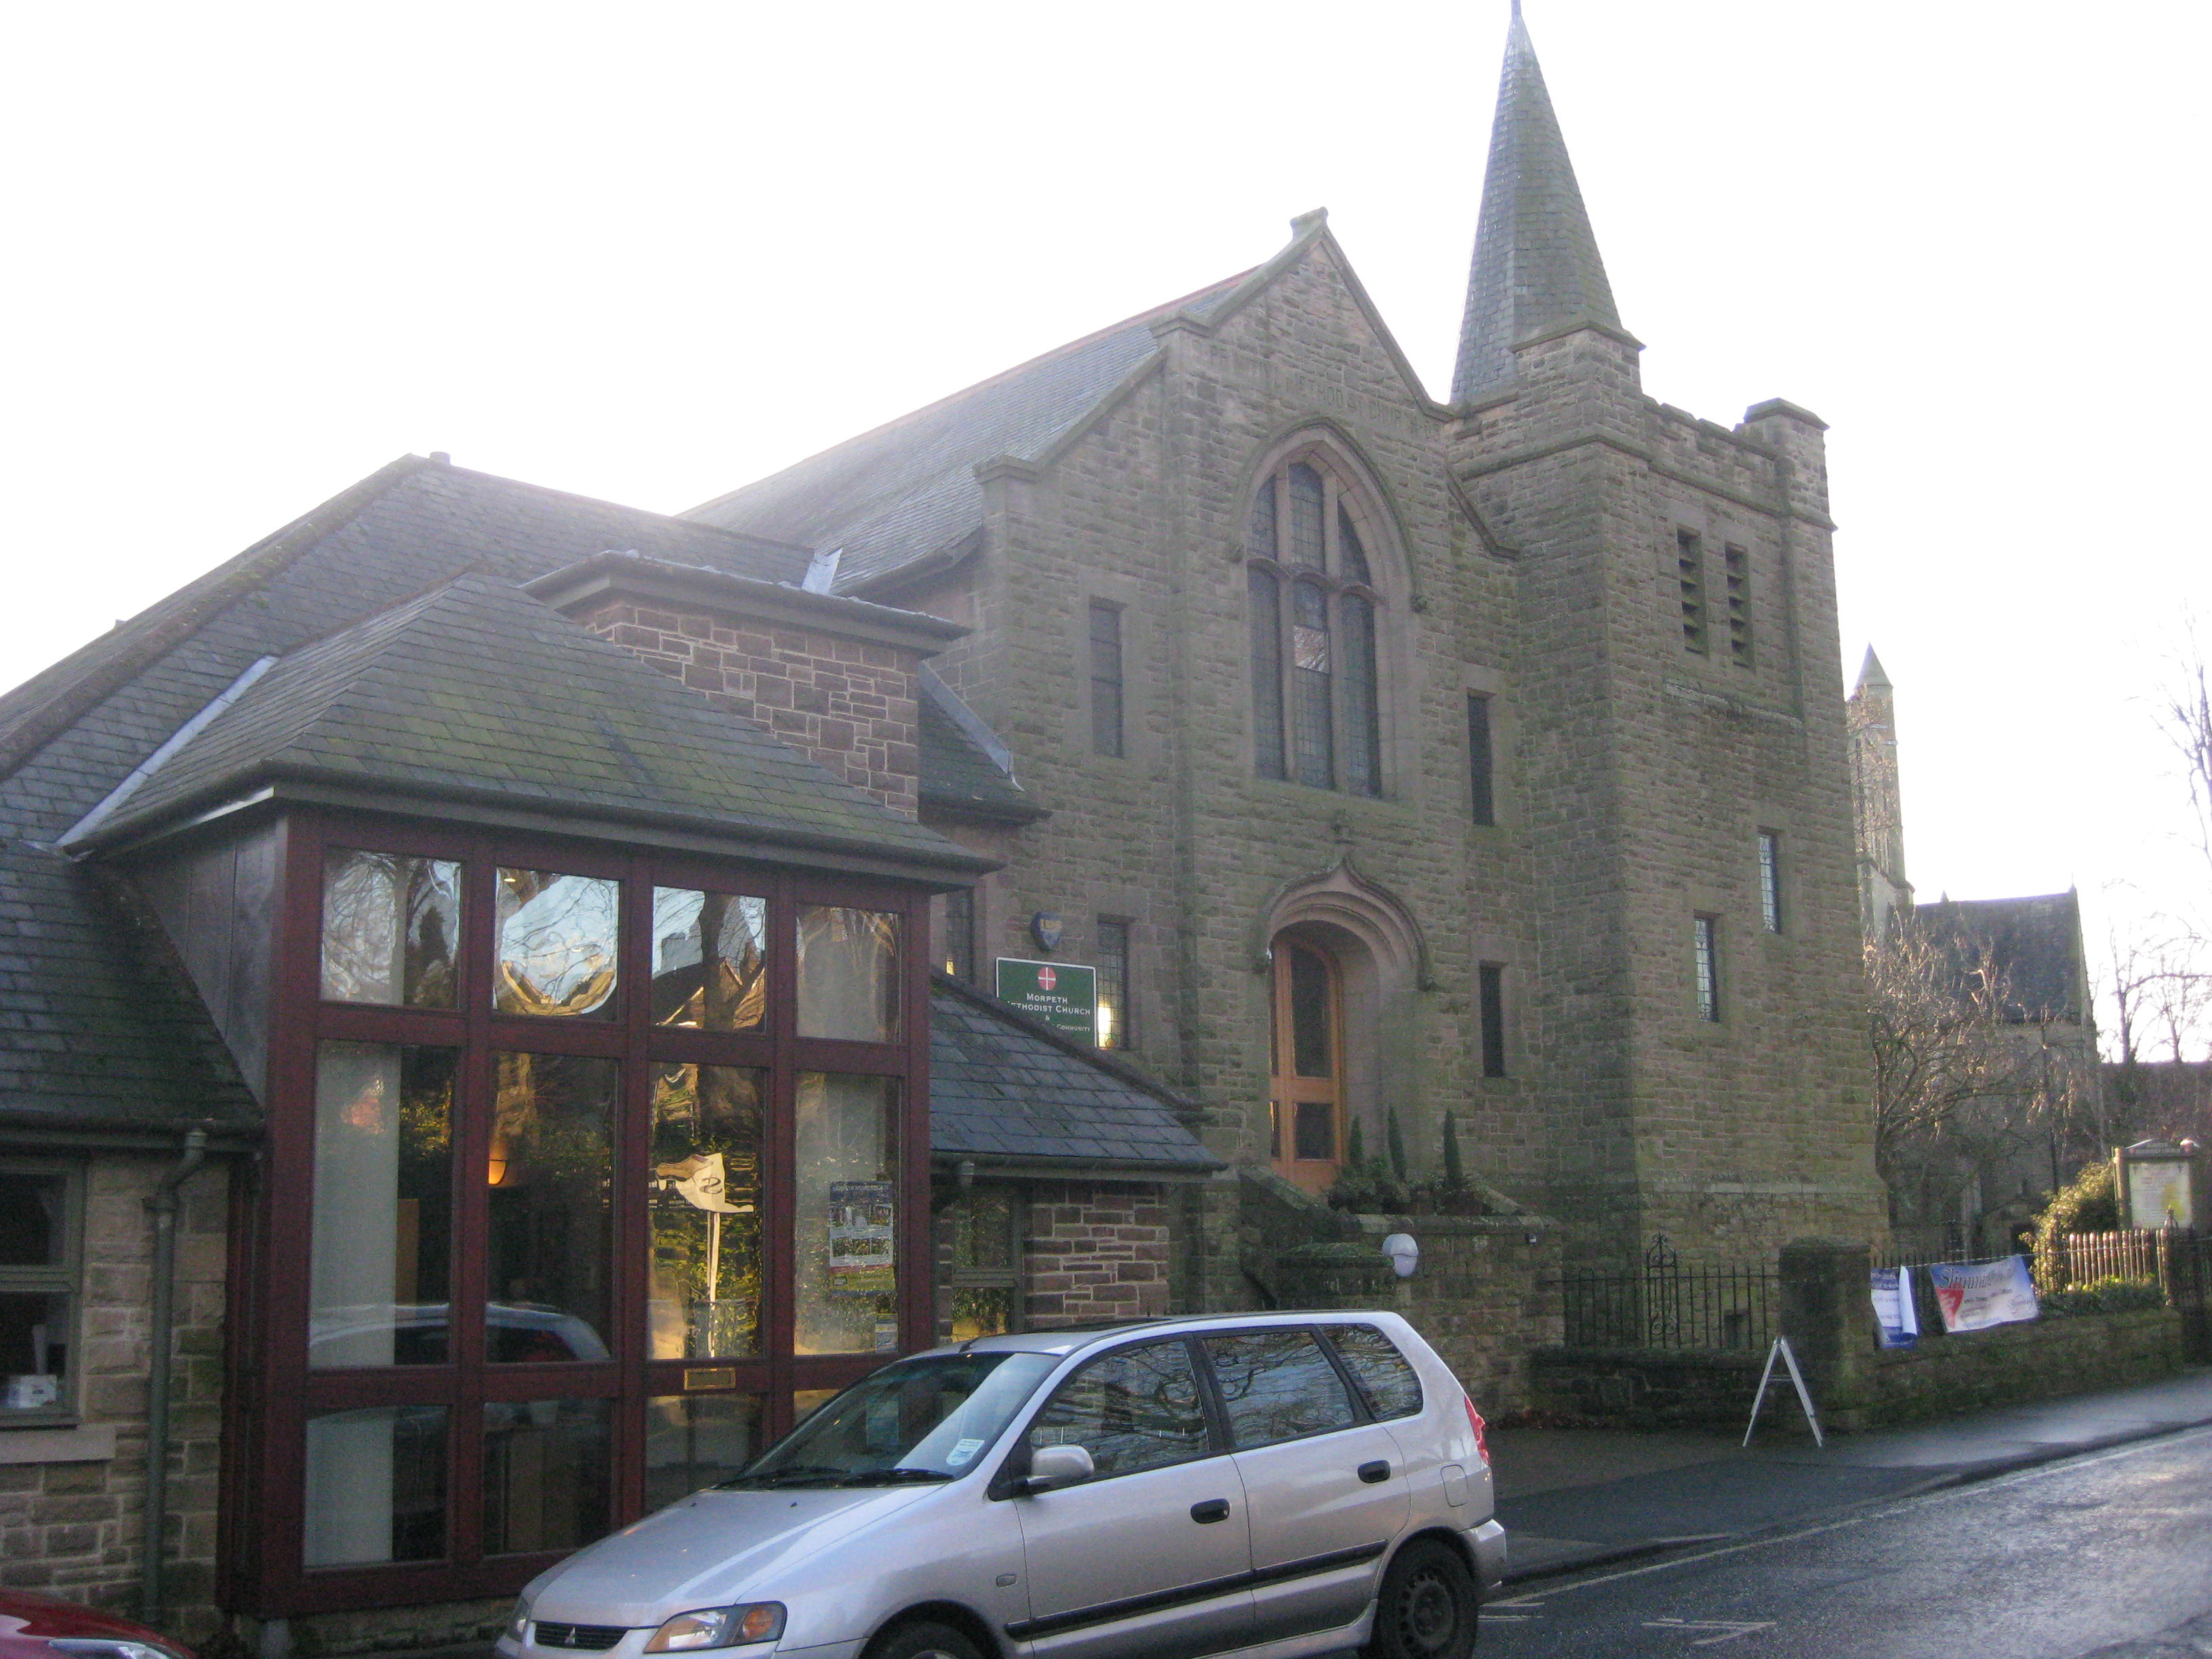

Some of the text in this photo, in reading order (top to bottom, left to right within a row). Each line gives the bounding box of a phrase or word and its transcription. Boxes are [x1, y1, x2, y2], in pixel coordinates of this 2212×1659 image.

[1027, 993, 1068, 1004] MORPETH
[1008, 1001, 1090, 1015] THODIST CHURCH
